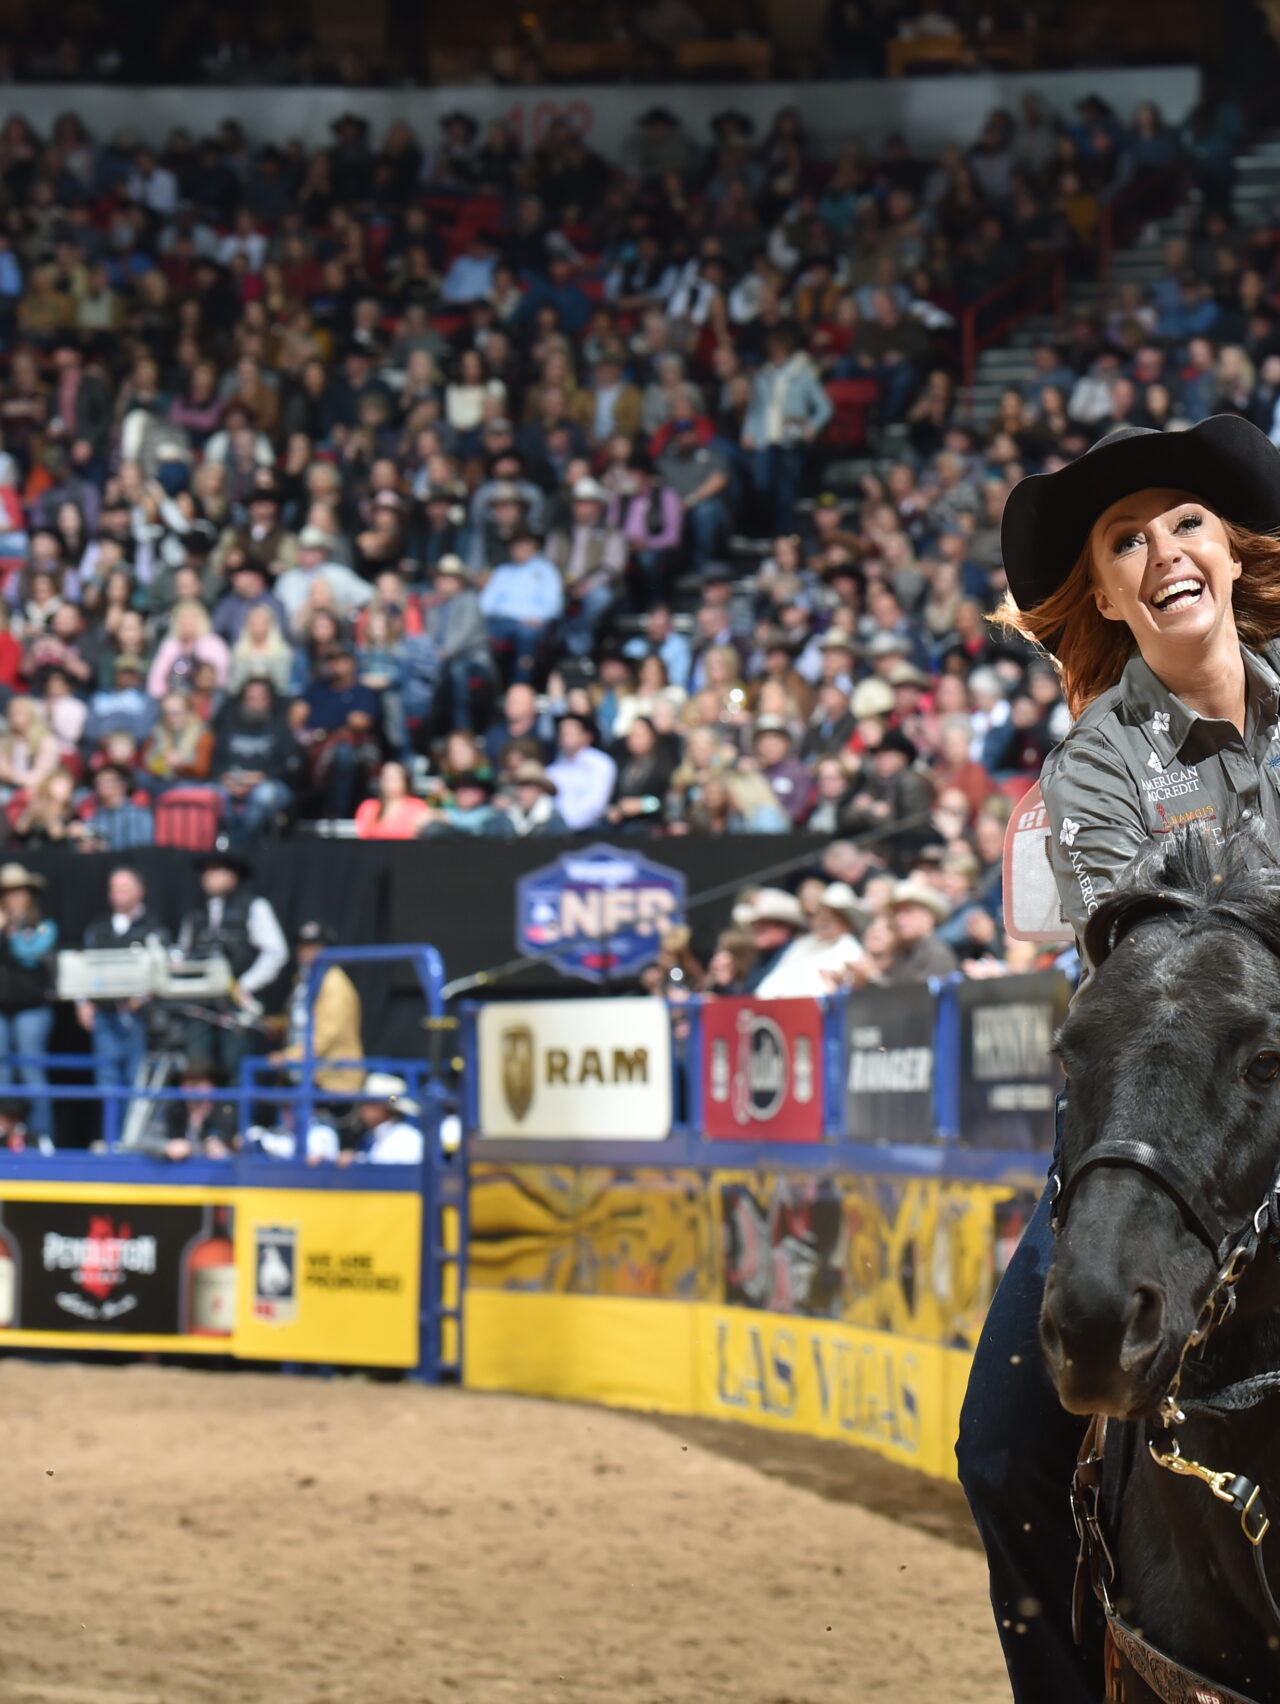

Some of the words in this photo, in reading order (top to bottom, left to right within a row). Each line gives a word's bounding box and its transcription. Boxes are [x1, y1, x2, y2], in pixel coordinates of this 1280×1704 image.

[1141, 766, 1198, 790] AMERICAN
[1068, 850, 1099, 916] AMERIC
[560, 887, 680, 938] NFR
[545, 1048, 649, 1084] RAM
[713, 1319, 797, 1418] LAS
